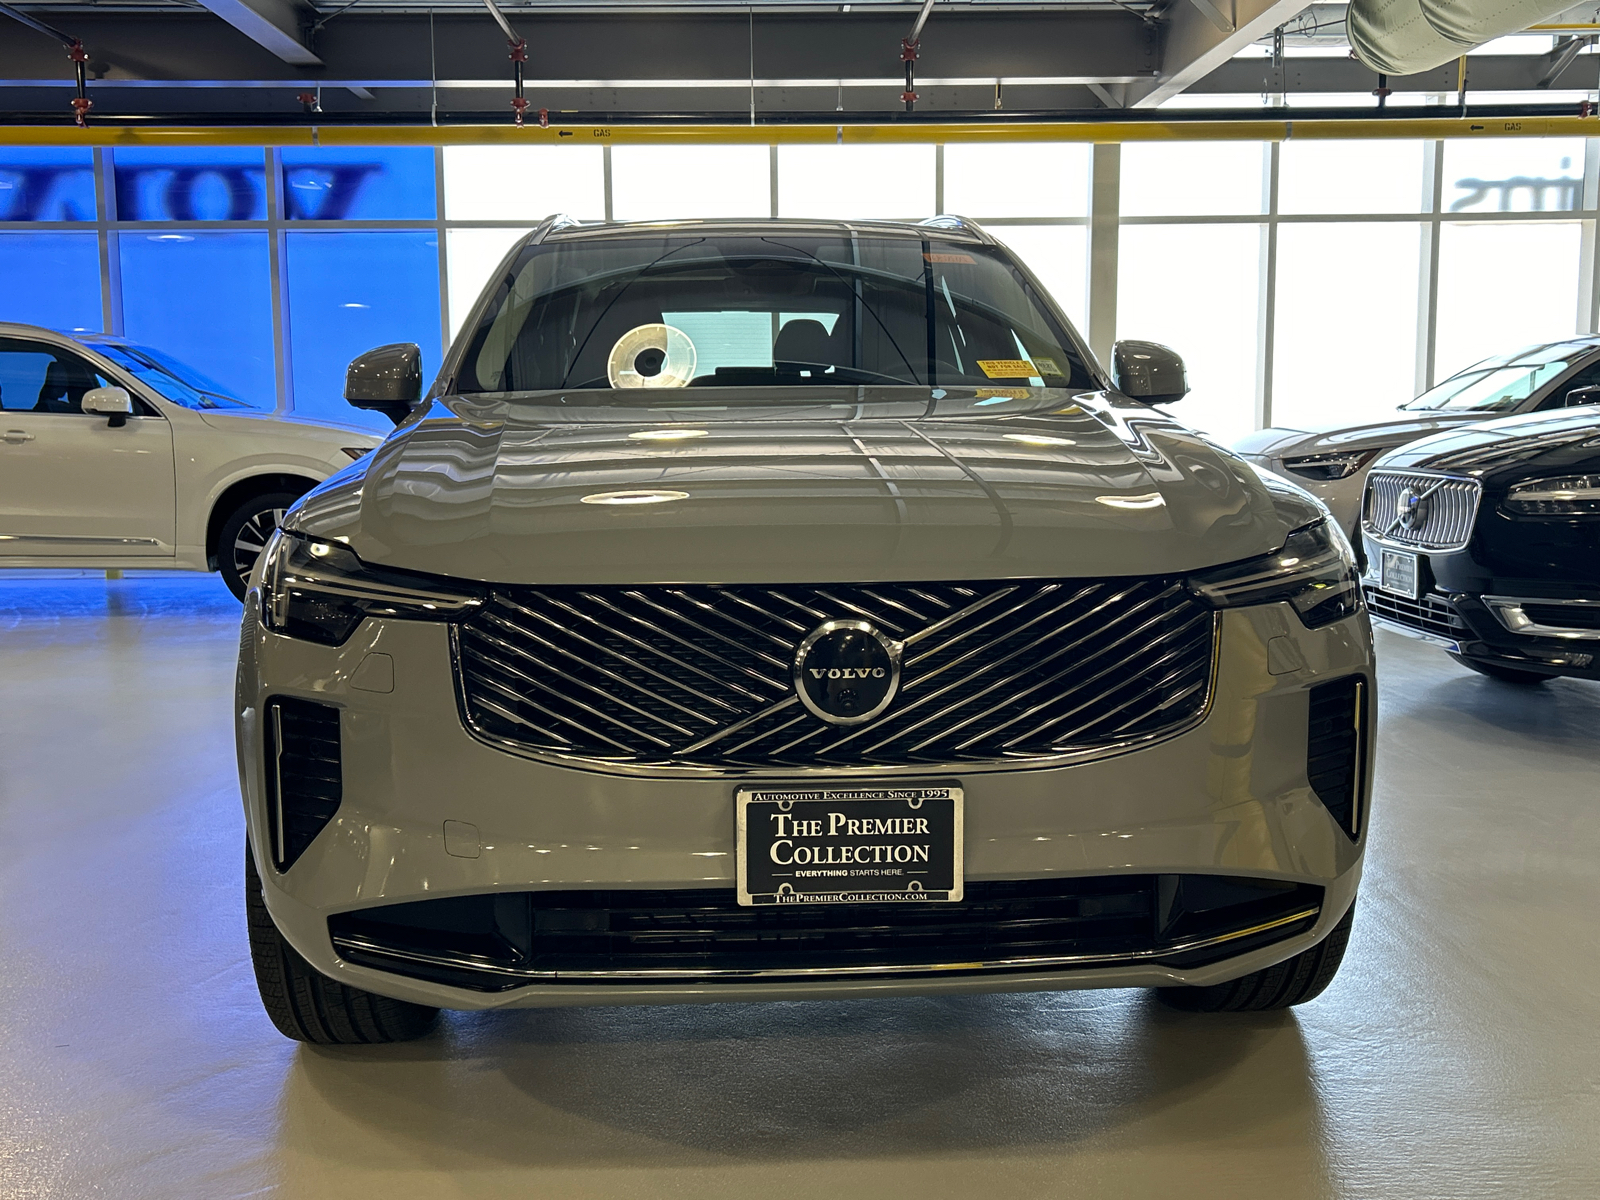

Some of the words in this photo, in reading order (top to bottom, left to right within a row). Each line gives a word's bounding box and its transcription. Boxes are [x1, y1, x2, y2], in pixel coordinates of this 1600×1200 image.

[1504, 122, 1522, 131] GAS
[593, 129, 611, 137] GAS
[809, 667, 886, 679] VOLVO
[754, 792, 820, 801] AUTOMOTIVE
[823, 791, 885, 800] EXCELLENCE
[887, 790, 917, 798] SINCE
[920, 789, 948, 798] 1995
[770, 813, 823, 837] THE
[827, 812, 931, 836] PREMIER
[769, 839, 931, 865] COLLECTION
[795, 869, 848, 878] EVERYTHING
[849, 869, 880, 877] STARTS
